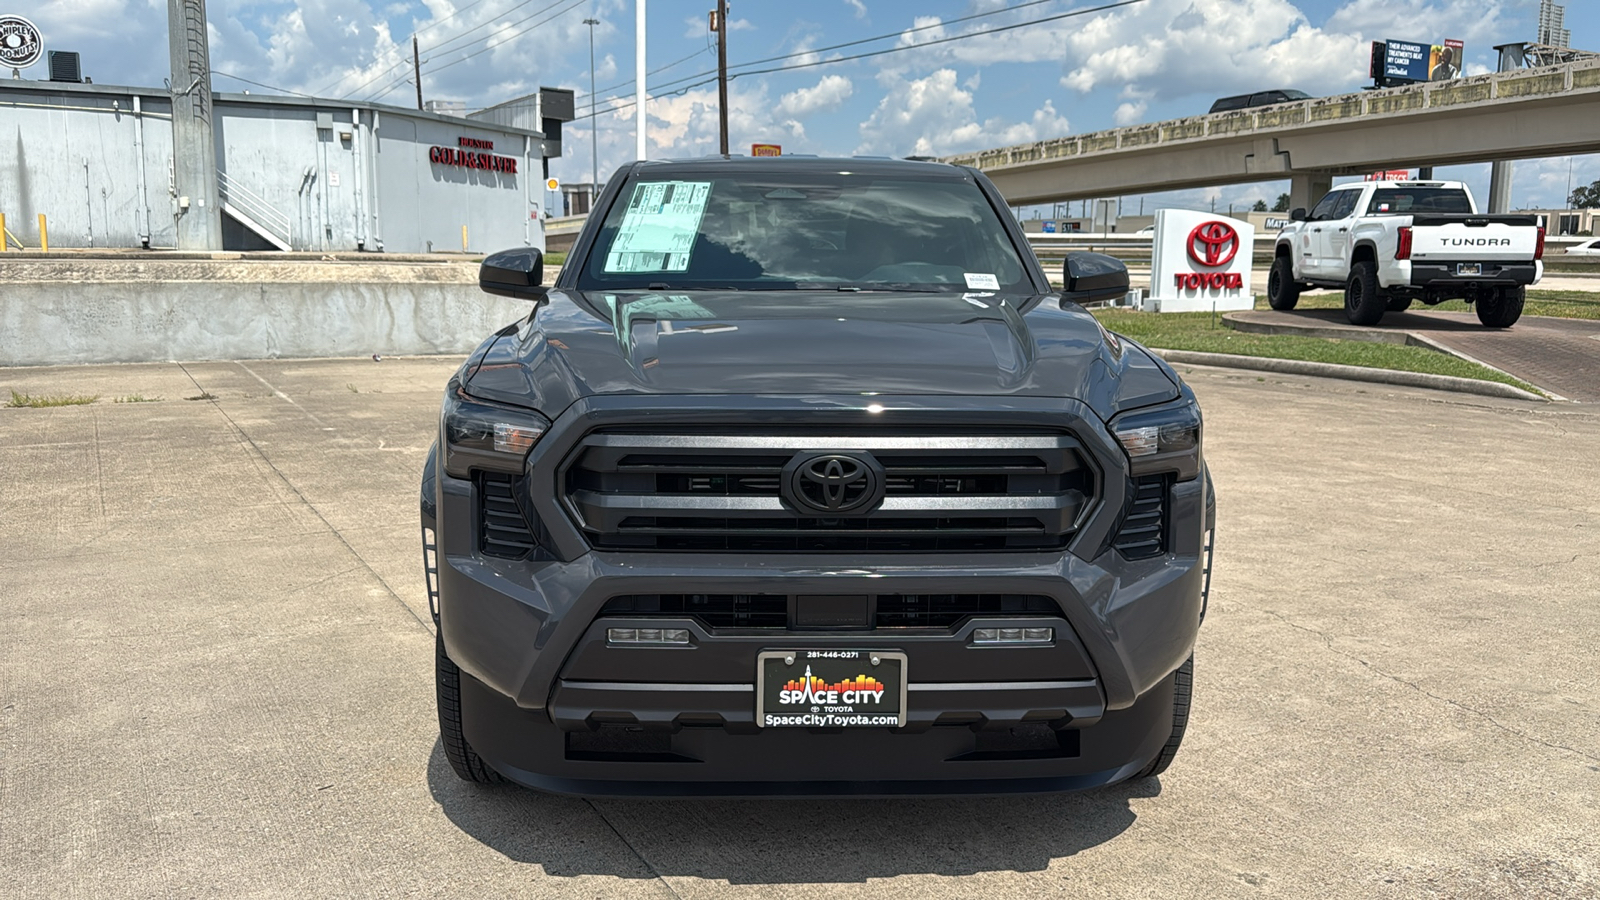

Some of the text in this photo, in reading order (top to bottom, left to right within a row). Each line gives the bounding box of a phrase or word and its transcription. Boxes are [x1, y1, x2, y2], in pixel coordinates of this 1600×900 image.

[1388, 42, 1421, 52] THEIR ADVANCED
[1388, 49, 1423, 60] TREATMENTS BEAT
[1394, 57, 1410, 65] CANCER
[459, 136, 493, 150] HOUSTON
[1440, 238, 1511, 246] TUNDRA
[1174, 273, 1243, 290] TOYOTA
[807, 651, 859, 659] 281-446-0271
[779, 689, 885, 704] SPACE CITY
[824, 705, 853, 713] TOYOTA
[765, 714, 898, 727] SpaceCityToyota.com
